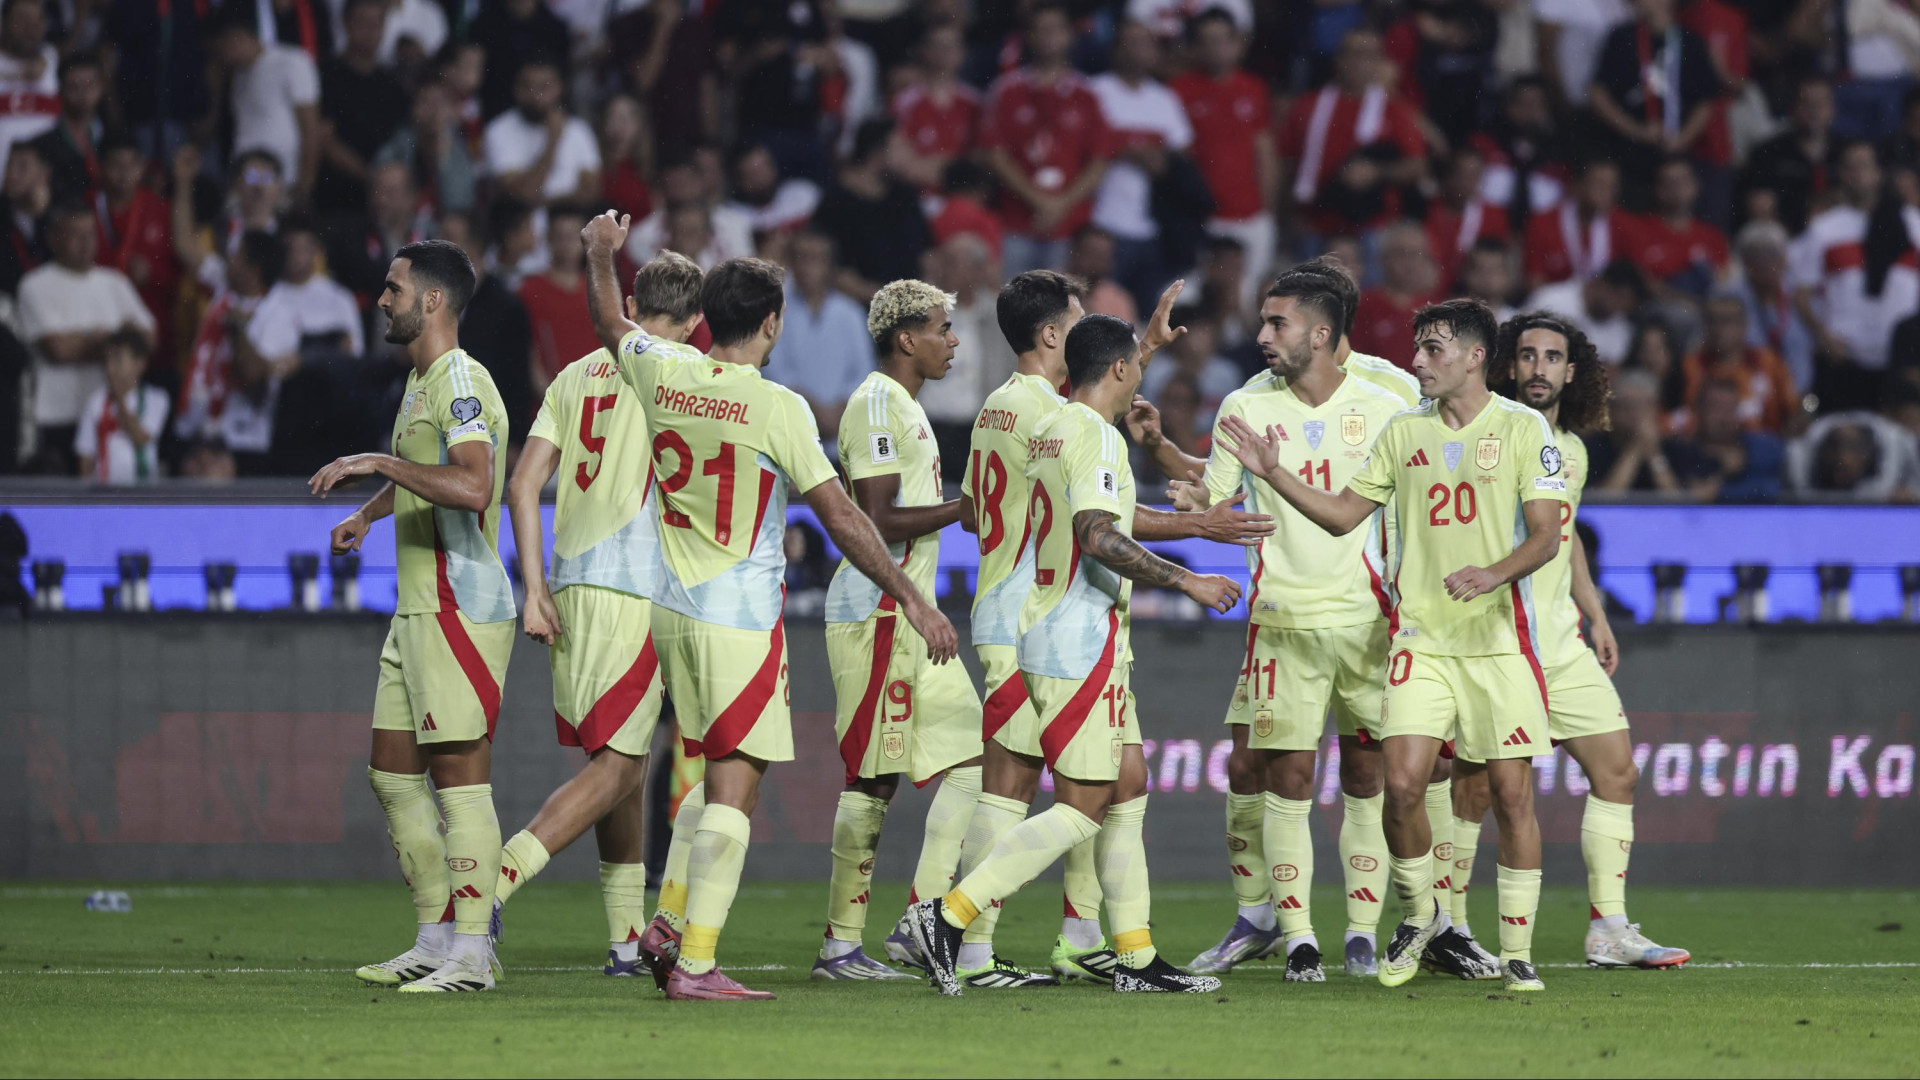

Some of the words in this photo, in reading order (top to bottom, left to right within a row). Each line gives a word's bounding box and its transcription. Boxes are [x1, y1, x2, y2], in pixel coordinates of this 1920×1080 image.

[654, 385, 749, 425] OYARZABAL
[575, 393, 618, 493] 5
[653, 429, 735, 547] 21
[1298, 459, 1332, 492] 11
[972, 449, 1008, 557] 18
[1428, 481, 1477, 527] 20
[1252, 658, 1277, 700] 11
[1385, 649, 1414, 691] 0
[881, 679, 913, 724] 19
[1103, 684, 1127, 728] 12
